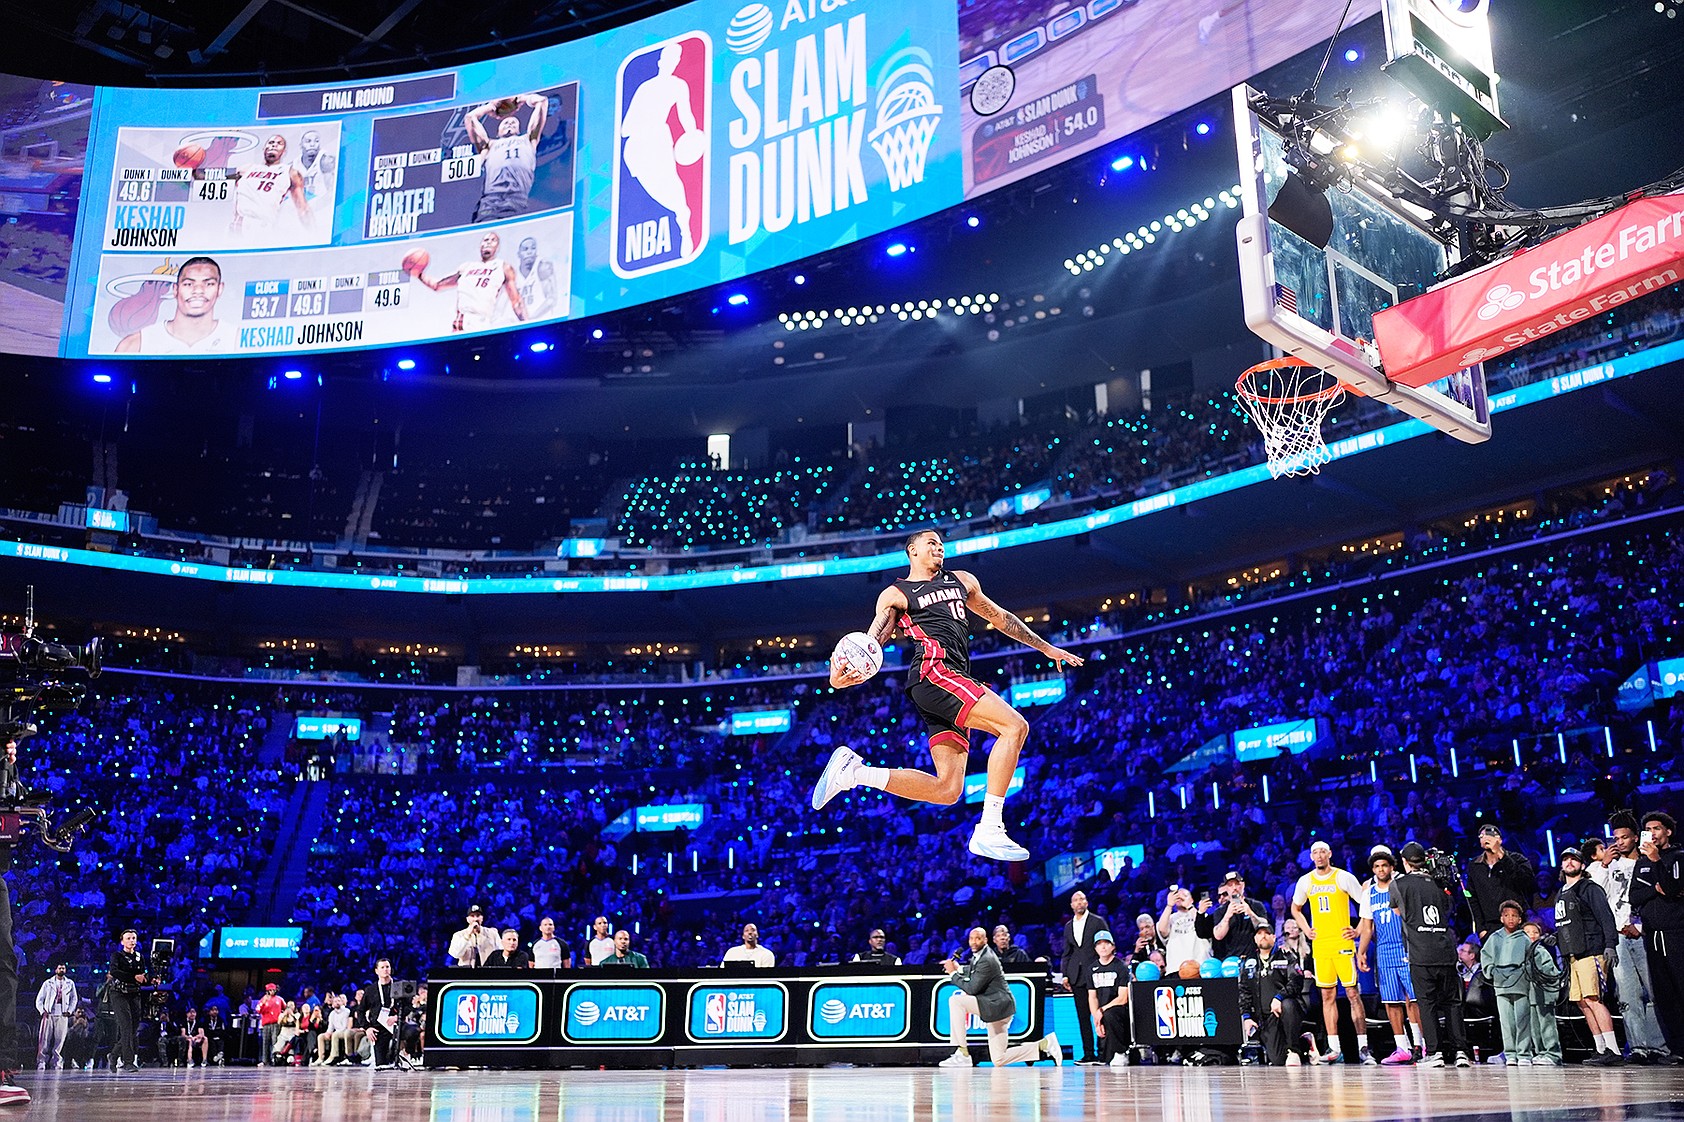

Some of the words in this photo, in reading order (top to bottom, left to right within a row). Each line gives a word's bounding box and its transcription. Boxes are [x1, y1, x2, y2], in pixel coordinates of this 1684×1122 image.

[729, 13, 867, 149] SLAM
[321, 89, 355, 112] FINAL
[355, 86, 395, 108] ROUND
[1024, 95, 1052, 123] SLAM
[1051, 83, 1078, 112] DUNK
[1063, 106, 1098, 136] 54.0
[1014, 124, 1047, 147] KESHAD
[505, 148, 520, 160] 11
[1008, 133, 1055, 164] JOHNSON
[123, 169, 145, 180] DUNK
[146, 169, 151, 180] 1
[160, 169, 183, 180] DUNK
[183, 169, 189, 180] 2
[247, 171, 281, 181] HEAT
[374, 167, 404, 191] 50.0
[448, 158, 475, 180] 50.0
[729, 108, 869, 245] DUNK
[119, 181, 151, 202] 49.6
[198, 181, 228, 201] 49.6
[257, 180, 275, 193] 16
[371, 187, 436, 217] CARTER
[114, 205, 186, 230] KESHAD
[369, 213, 419, 237] BRYANT
[111, 228, 178, 247] JOHNSON
[624, 215, 672, 263] NBA
[1528, 244, 1616, 300] State
[254, 281, 279, 295] CLOCK
[297, 280, 317, 292] DUNK
[335, 277, 354, 289] DUNK
[475, 277, 489, 289] 16
[250, 297, 280, 318] 53.7
[292, 295, 322, 315] 49.6
[374, 287, 401, 308] 49.6
[1502, 306, 1591, 348] State
[1588, 267, 1679, 312] Farm
[239, 325, 294, 348] KESHAD
[297, 320, 363, 346] JOHNSON
[917, 588, 963, 609] MIAMI
[947, 599, 967, 620] 16
[1318, 895, 1331, 913] 11
[1379, 909, 1392, 925] 11
[479, 1002, 508, 1018] SLAM
[602, 1005, 650, 1022] AT&T
[727, 1000, 755, 1017] SLAM
[849, 1002, 896, 1019] AT&T
[1176, 996, 1205, 1018] SLAM
[478, 1018, 507, 1034] DUNK
[726, 1016, 754, 1033] DUNK
[1178, 1016, 1207, 1038] DUNK
